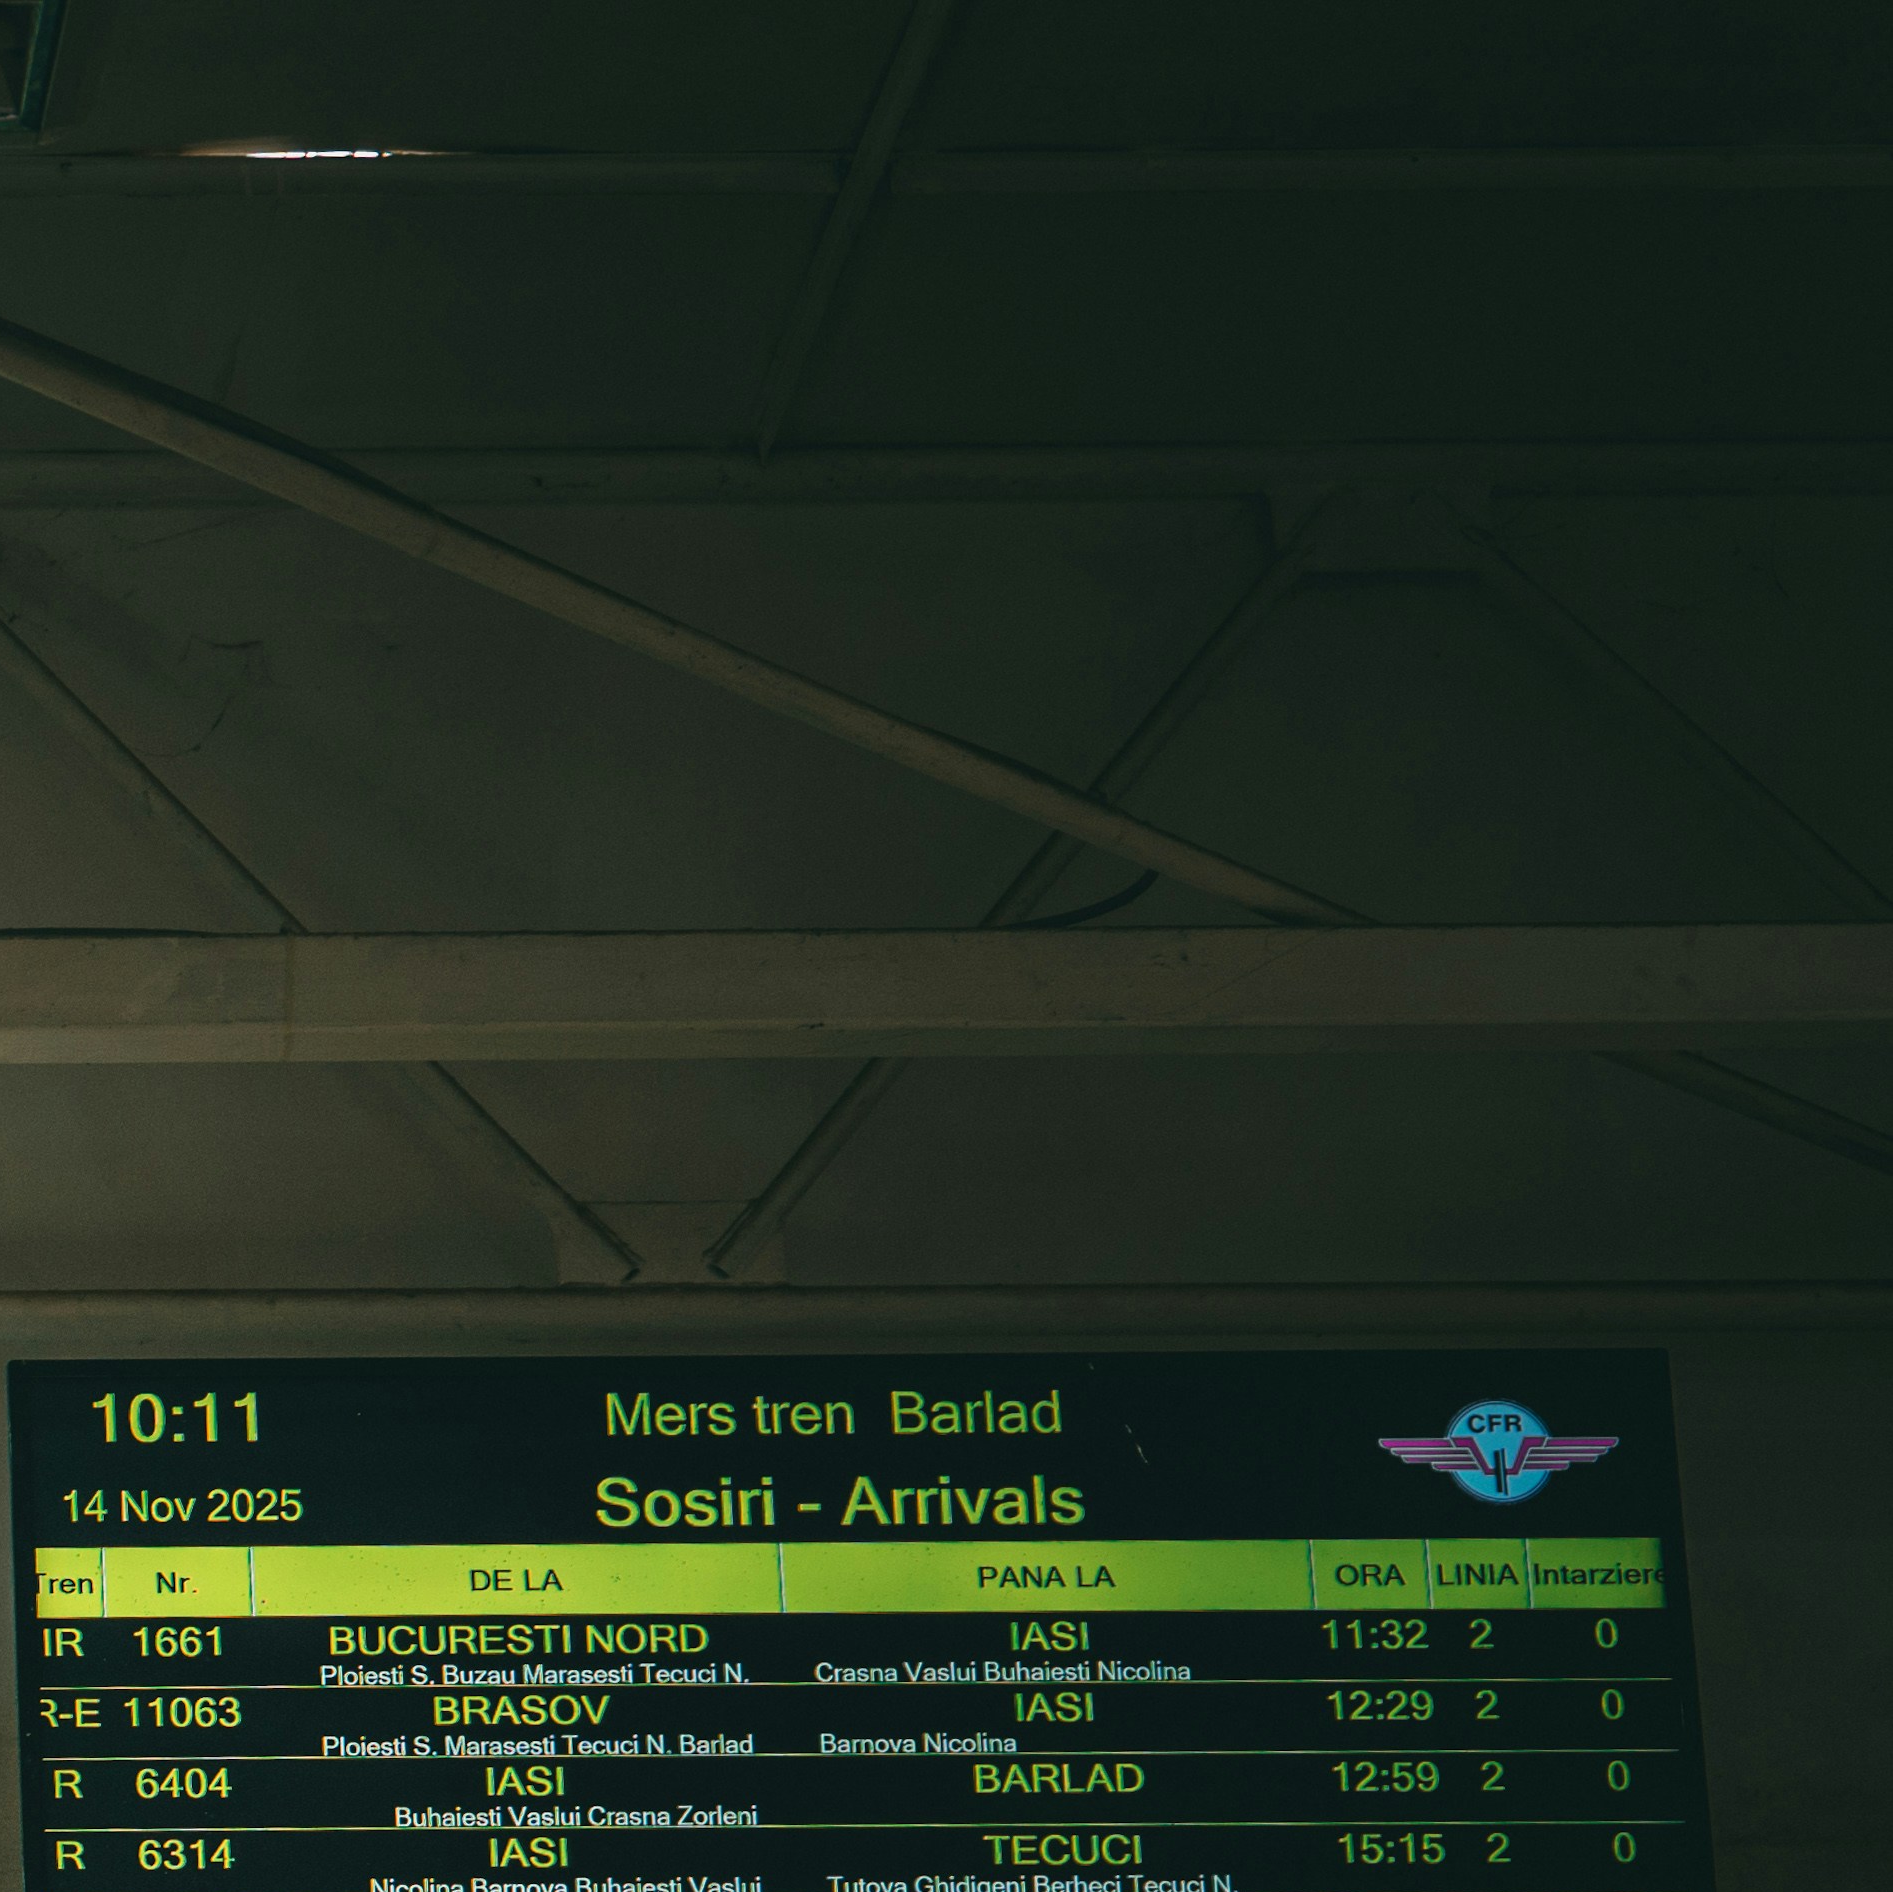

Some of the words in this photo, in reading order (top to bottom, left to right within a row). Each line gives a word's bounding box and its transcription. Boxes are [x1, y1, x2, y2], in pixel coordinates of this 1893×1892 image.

[92, 1392, 259, 1443] 10:11
[606, 1392, 737, 1436] Mers
[752, 1395, 855, 1435] tren
[891, 1389, 1062, 1434] Barlad
[1467, 1413, 1523, 1434] CFR
[63, 1489, 108, 1522] 14
[121, 1489, 197, 1523] Nov
[207, 1488, 304, 1522] 2025
[596, 1476, 775, 1528] Sosiri
[798, 1502, 823, 1512] -
[841, 1474, 1086, 1526] Arrivals
[156, 1571, 197, 1594] Nr.
[470, 1569, 513, 1592] DE
[524, 1569, 564, 1592] LA
[978, 1565, 1067, 1589] PANA
[1076, 1565, 1117, 1588] LA
[1335, 1563, 1406, 1587] ORA
[1437, 1563, 1520, 1586] LINIA
[43, 1627, 85, 1657] IR
[133, 1625, 222, 1657] 1661
[329, 1624, 572, 1656] BUCURESTI
[586, 1623, 709, 1654] NORD
[1010, 1620, 1090, 1651] IASI
[1322, 1618, 1429, 1650] 11:32
[1470, 1618, 1495, 1649] 2
[1595, 1617, 1618, 1649] 0
[320, 1664, 404, 1686] Ploiesti
[411, 1664, 435, 1686] S.
[442, 1664, 515, 1686] Buzau
[522, 1663, 633, 1686] Marasesti
[638, 1662, 716, 1686] Tecuci
[724, 1662, 749, 1686] N.
[815, 1661, 898, 1683] Crasna
[903, 1660, 976, 1683] Vaslui
[984, 1660, 1090, 1683] Buhaiesti
[1097, 1660, 1191, 1683] Nicolina
